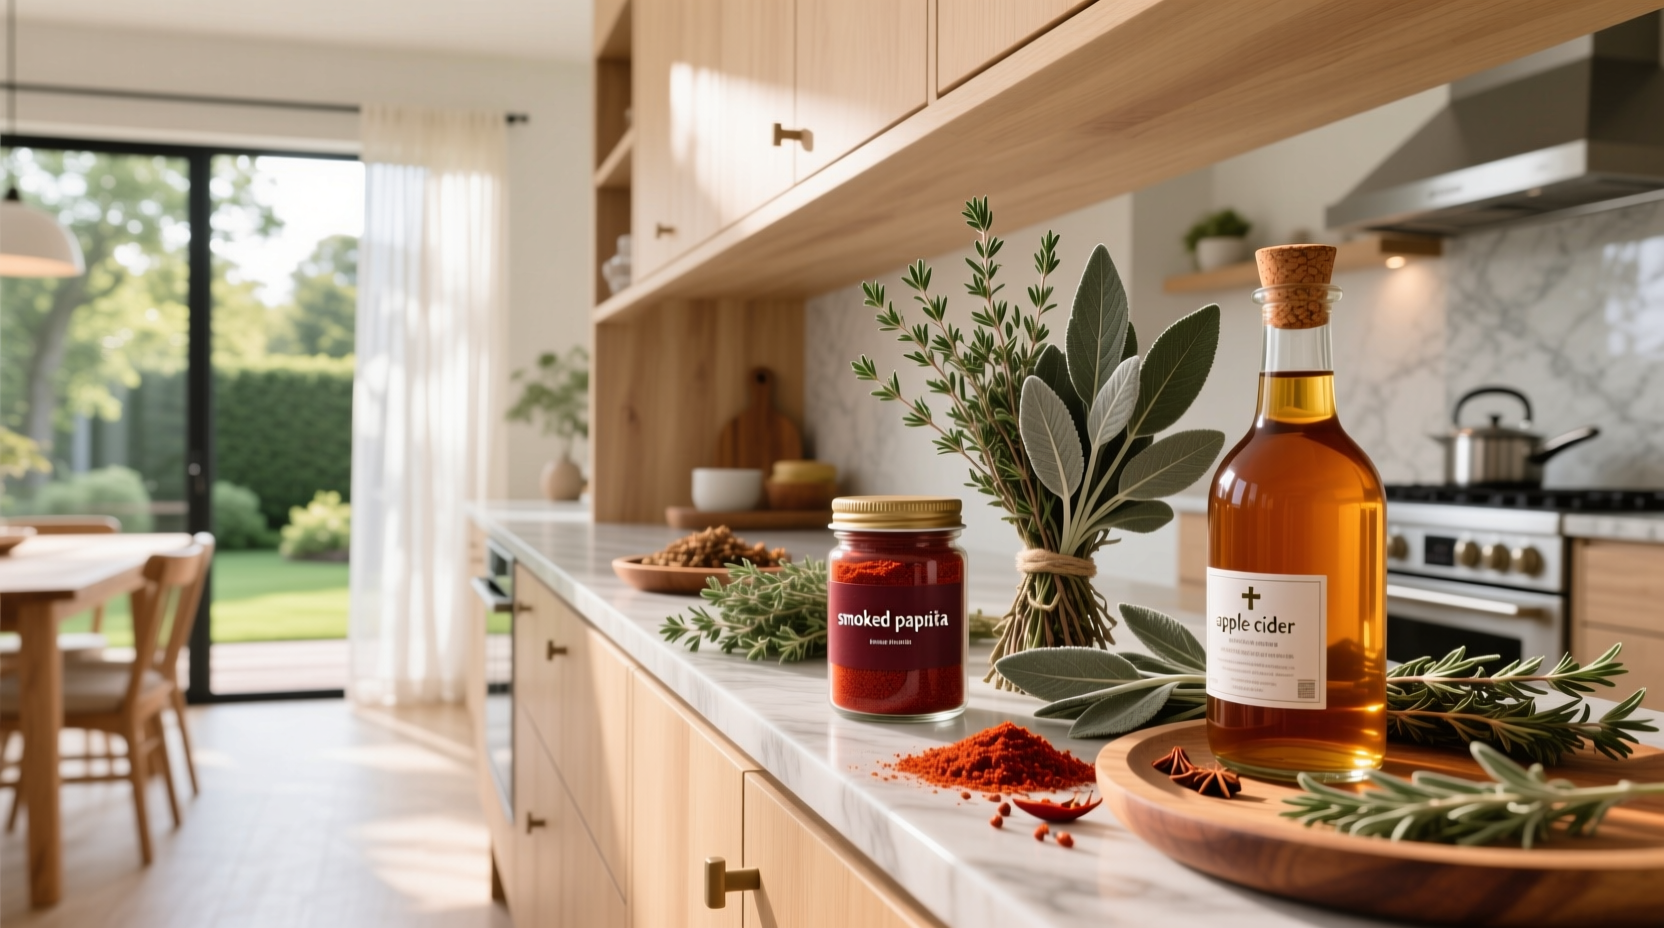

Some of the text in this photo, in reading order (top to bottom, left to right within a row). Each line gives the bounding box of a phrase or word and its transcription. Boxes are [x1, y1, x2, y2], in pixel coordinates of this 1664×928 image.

[837, 609, 891, 628] smoked
[1216, 612, 1296, 635] apple cider
